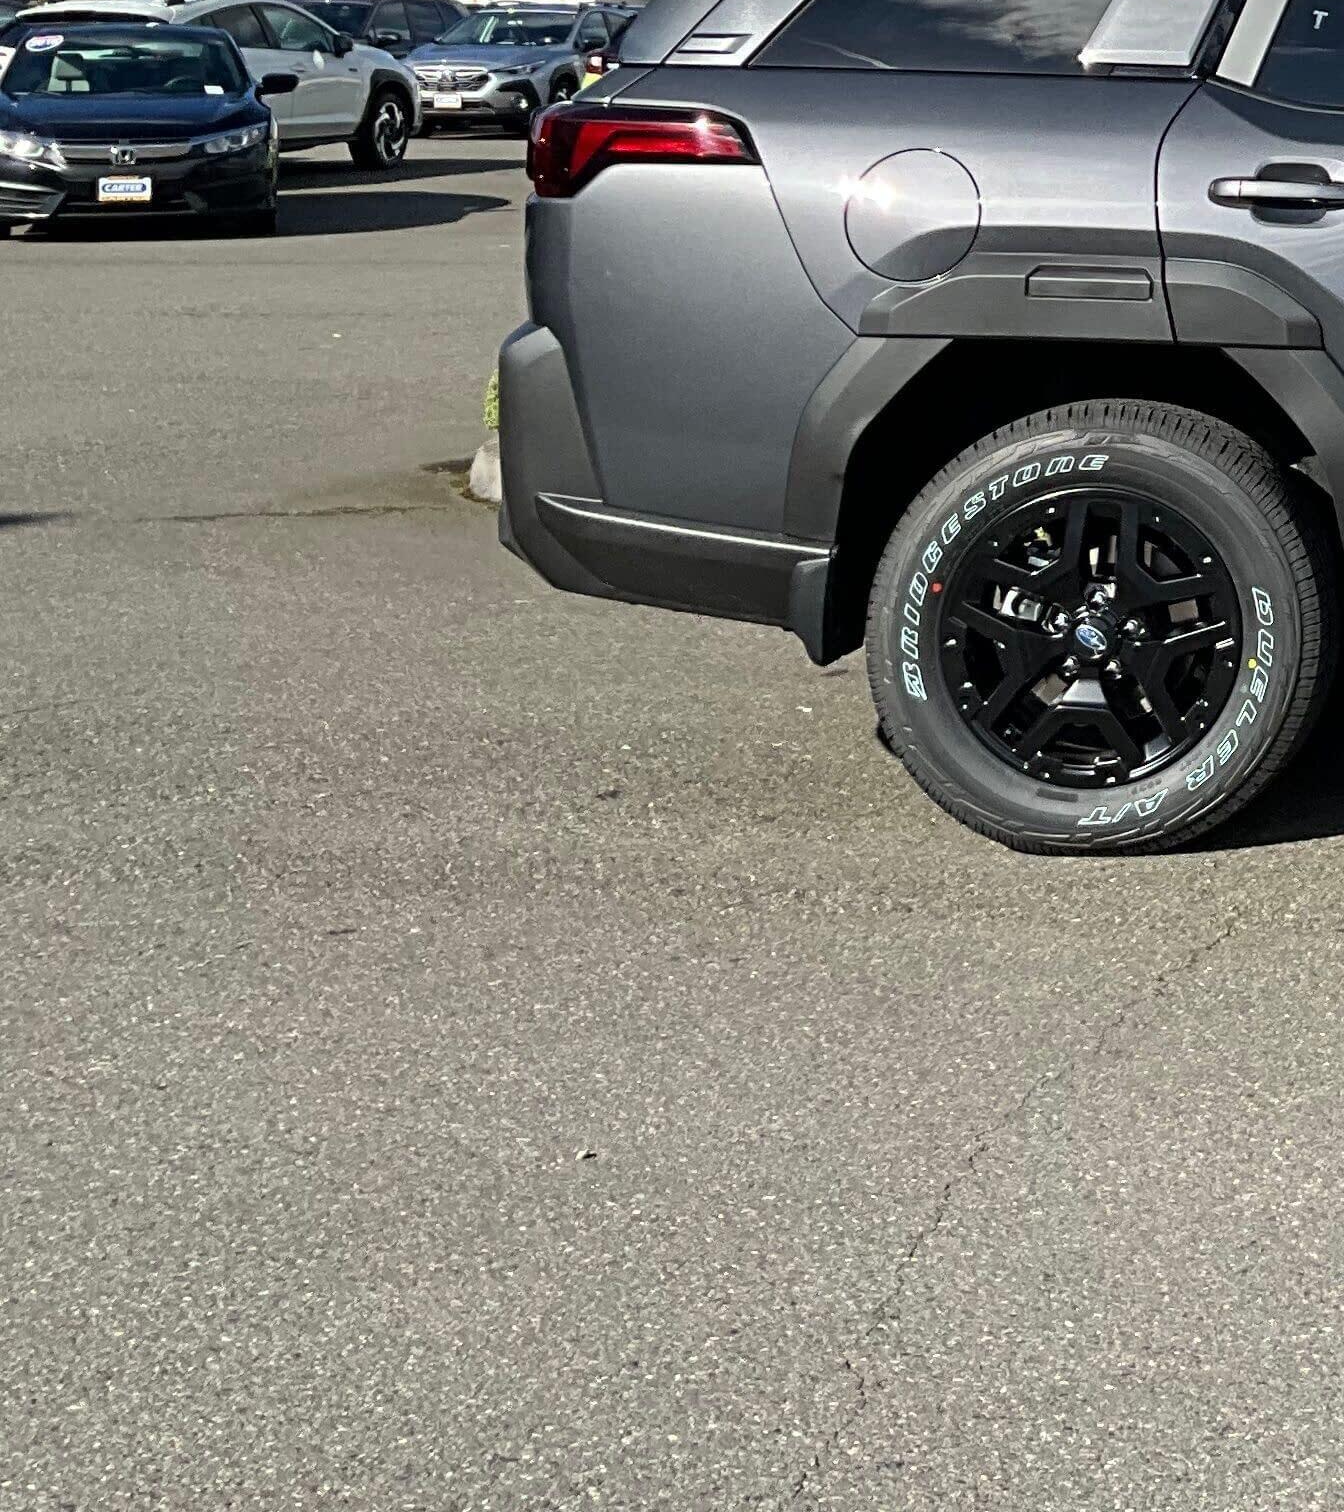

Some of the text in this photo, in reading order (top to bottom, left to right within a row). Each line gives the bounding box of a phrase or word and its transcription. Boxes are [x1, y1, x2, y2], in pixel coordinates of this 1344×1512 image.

[104, 183, 143, 192] CARTER
[900, 454, 1110, 702] BRIDGESTONE
[1185, 587, 1275, 791] DUELER
[1077, 788, 1169, 826] A/T
